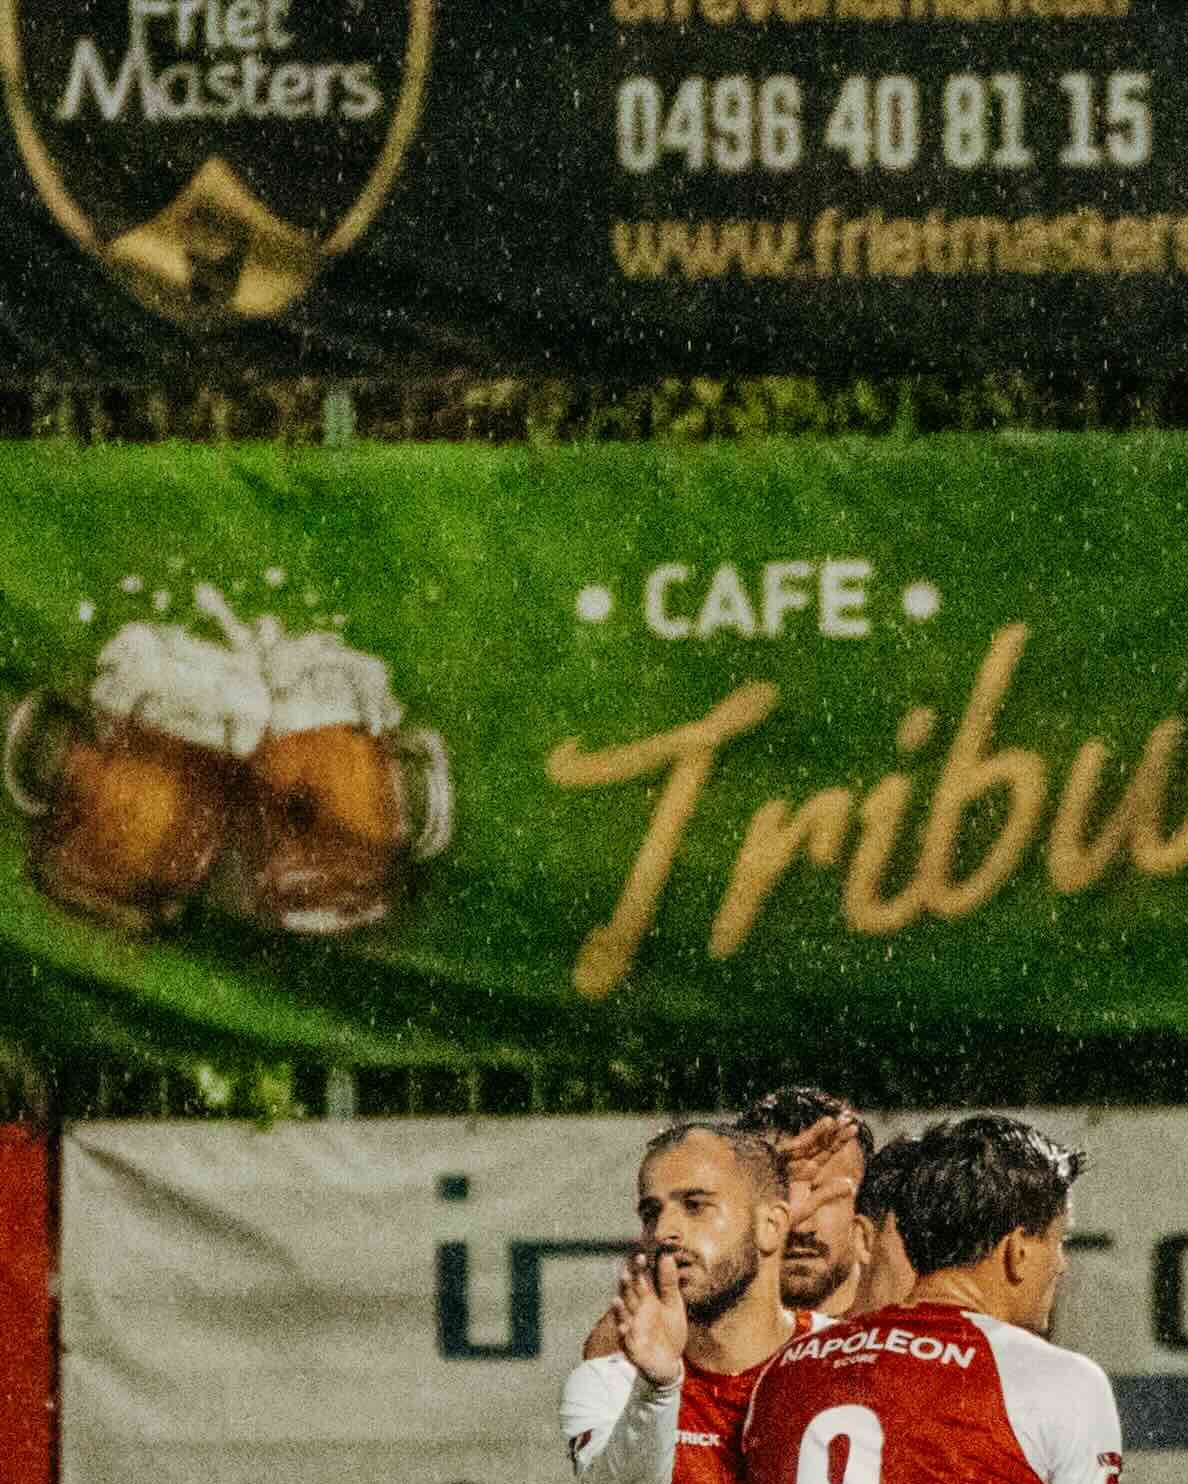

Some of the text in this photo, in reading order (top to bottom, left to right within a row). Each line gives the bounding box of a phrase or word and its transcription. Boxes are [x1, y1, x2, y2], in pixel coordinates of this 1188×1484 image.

[56, 37, 383, 120] Masters
[616, 71, 1155, 174] 0496 40 81 15
[644, 557, 874, 641] CAFE
[778, 1327, 976, 1369] NAPOLEON
